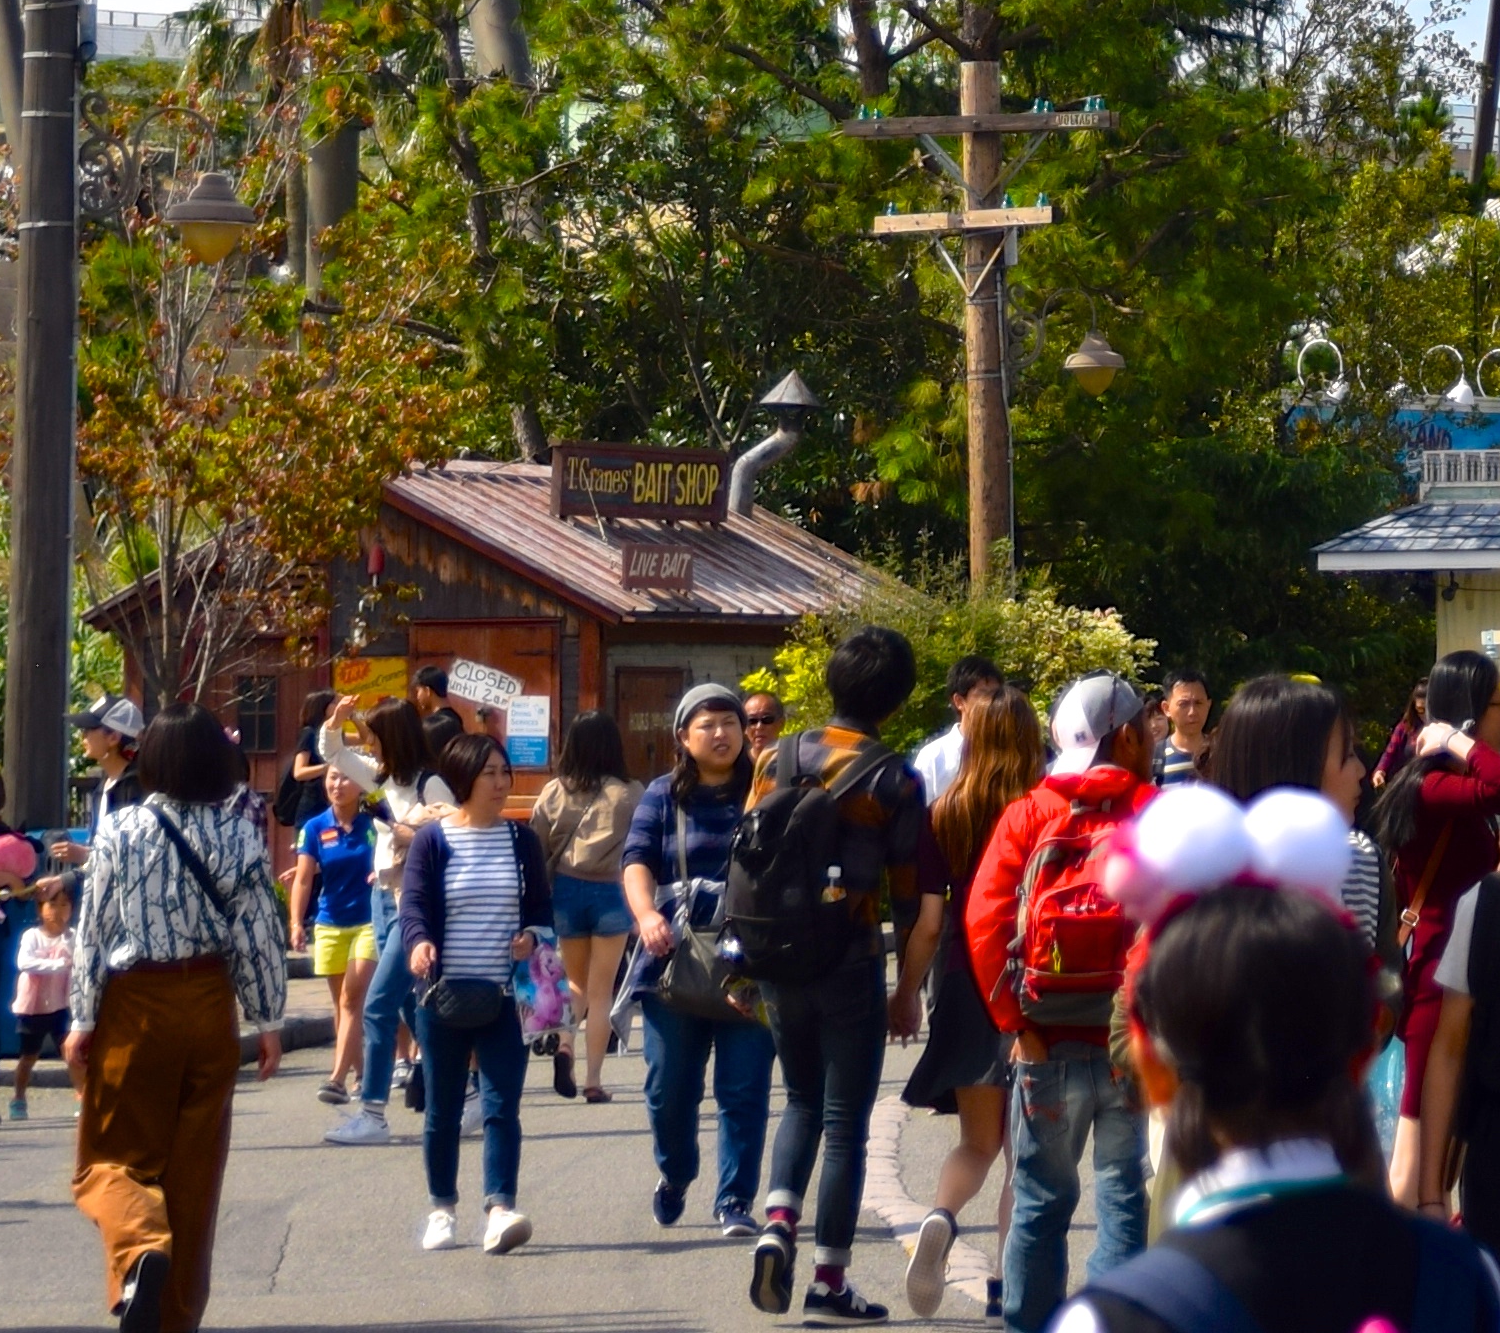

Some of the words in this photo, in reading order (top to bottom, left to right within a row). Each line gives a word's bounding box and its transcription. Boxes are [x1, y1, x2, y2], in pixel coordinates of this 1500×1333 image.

[1058, 114, 1099, 126] VOLTAGE
[633, 461, 674, 504] BAIT
[674, 463, 720, 506] SHOP
[629, 550, 658, 577] LIVE
[659, 552, 692, 579] BAIT
[449, 678, 478, 697] until
[454, 661, 517, 695] CLOSED
